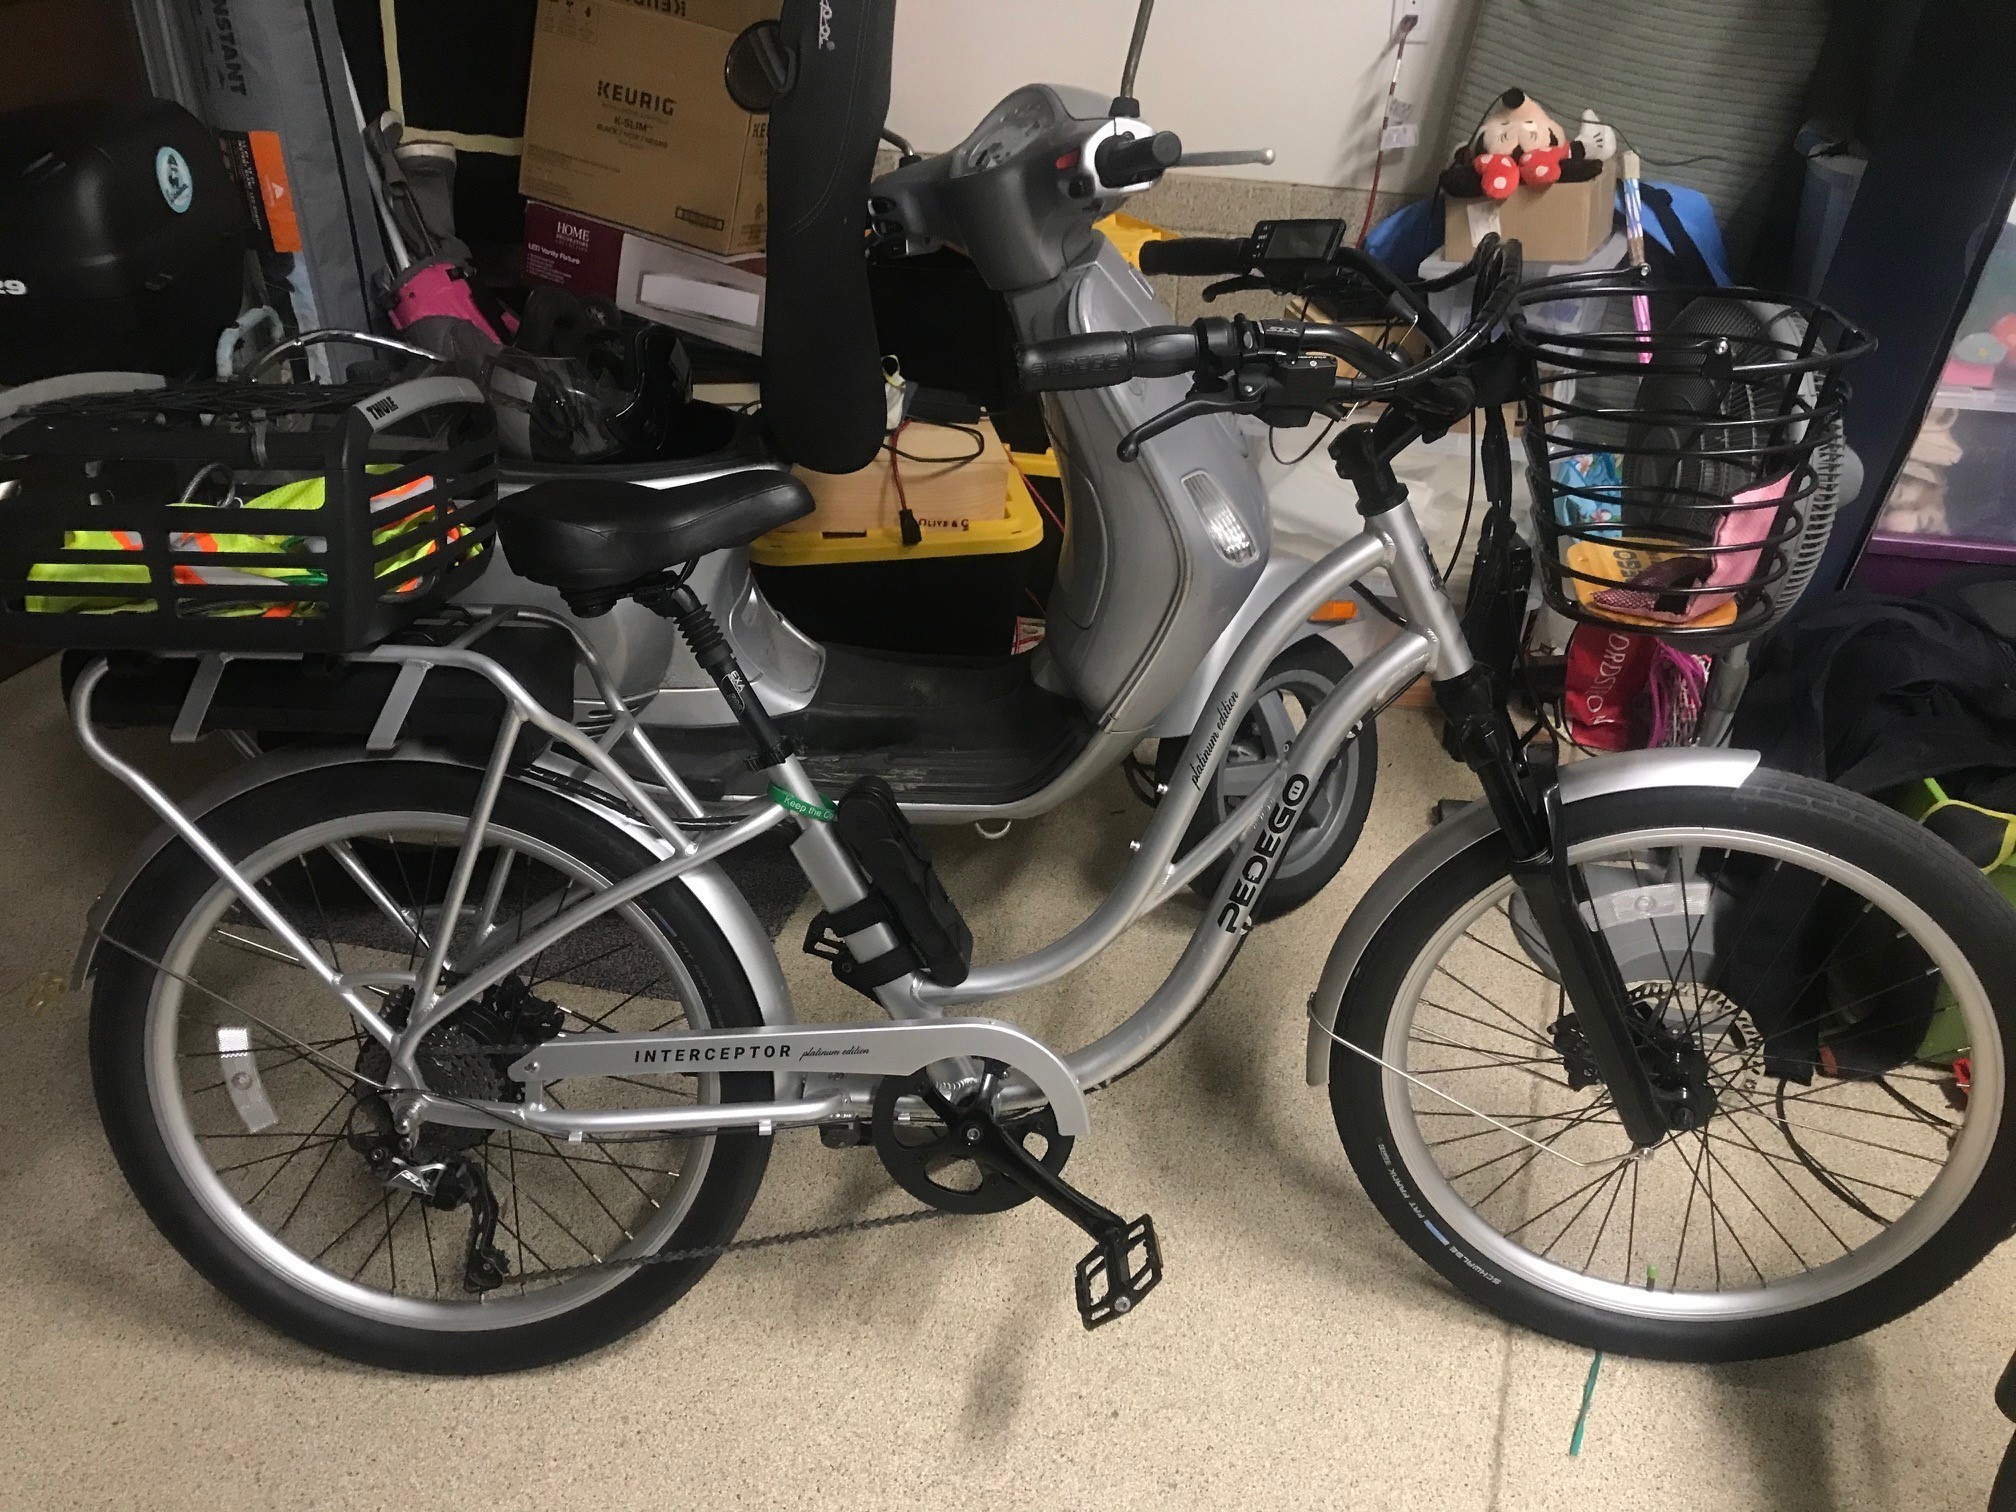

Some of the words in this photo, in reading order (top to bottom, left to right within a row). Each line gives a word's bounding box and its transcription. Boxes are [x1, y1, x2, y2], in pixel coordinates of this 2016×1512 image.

[597, 80, 677, 117] KEURIG
[753, 122, 768, 139] KE
[557, 221, 590, 242] HOME
[541, 246, 559, 259] Vanity
[559, 252, 581, 265] Fixture
[366, 395, 399, 420] THULE
[918, 518, 948, 528] OLIVE
[951, 520, 958, 528] &
[730, 670, 746, 694] EXA
[1189, 731, 1220, 791] platinum
[1216, 690, 1239, 731] edition
[784, 795, 807, 812] Keep
[808, 806, 822, 818] the
[1217, 773, 1310, 934] PEDEGO
[634, 1044, 792, 1063] INTERCEPTOR
[798, 1046, 840, 1061] platinum
[841, 1045, 870, 1056] edition
[1388, 1167, 1411, 1199] FRANK
[1408, 1201, 1426, 1219] FAT
[1449, 1245, 1502, 1285] SCHWALBE
